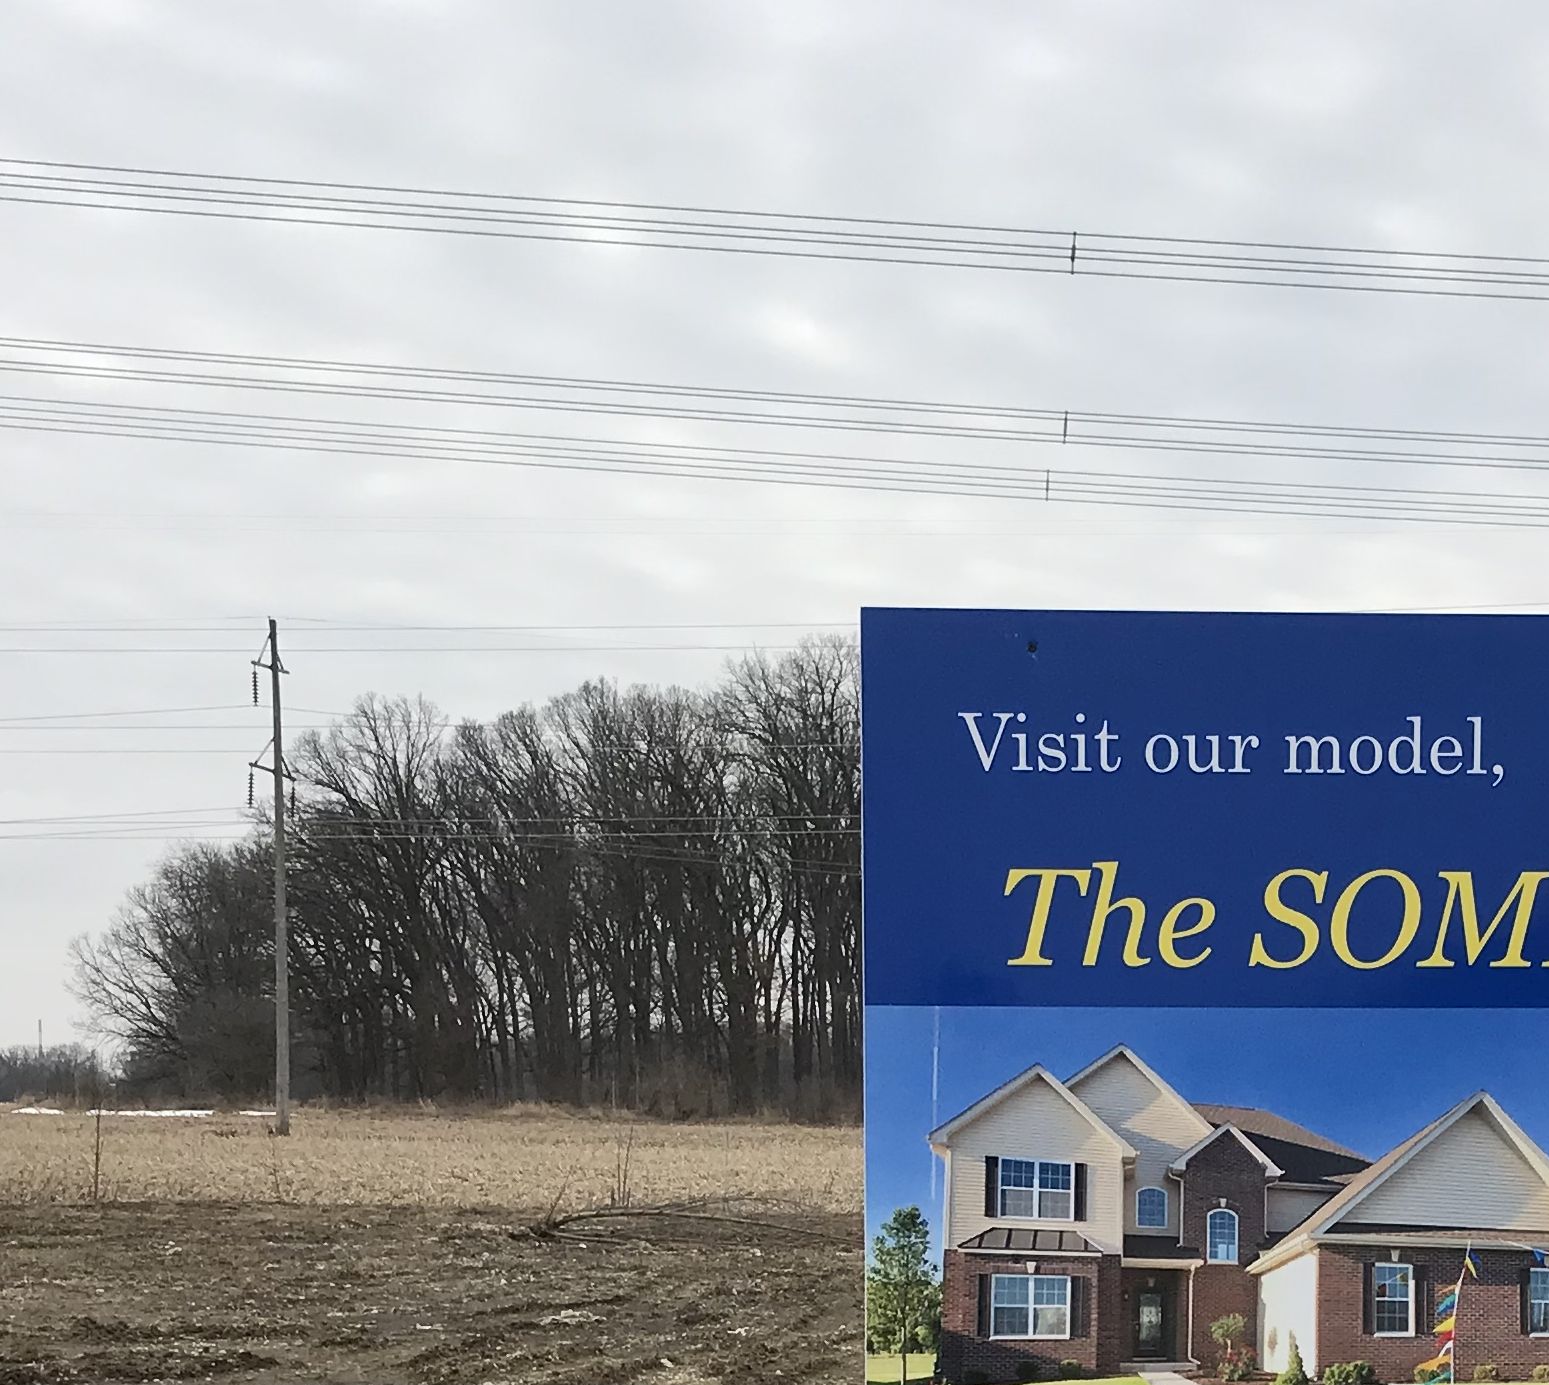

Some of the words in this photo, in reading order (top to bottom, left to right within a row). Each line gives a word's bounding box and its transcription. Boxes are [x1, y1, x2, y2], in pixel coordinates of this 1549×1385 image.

[957, 711, 1122, 775] Visit
[1143, 730, 1260, 776] our
[1284, 715, 1506, 788] model,
[1002, 861, 1216, 970] The
